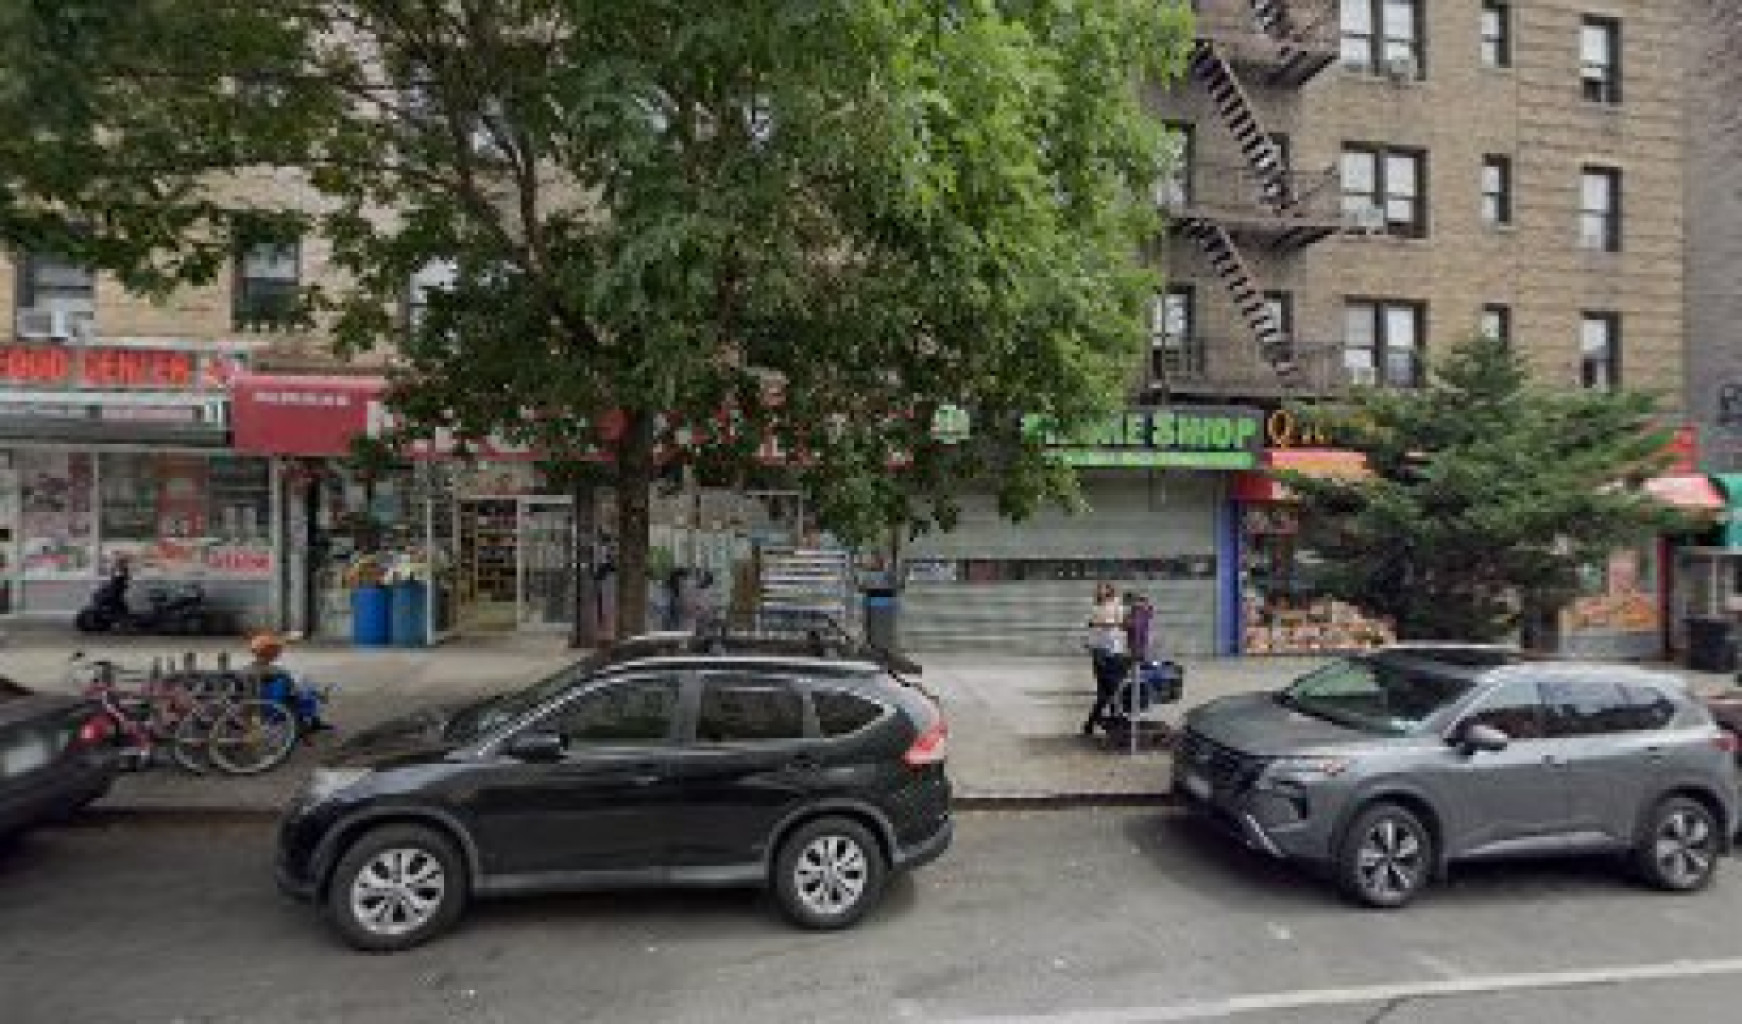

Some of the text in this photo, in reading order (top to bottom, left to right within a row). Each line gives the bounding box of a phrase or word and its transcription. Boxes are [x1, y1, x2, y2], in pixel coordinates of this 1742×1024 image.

[84, 350, 189, 386] CENTER
[1021, 412, 1146, 446] SKE
[1152, 411, 1257, 448] SHOP
